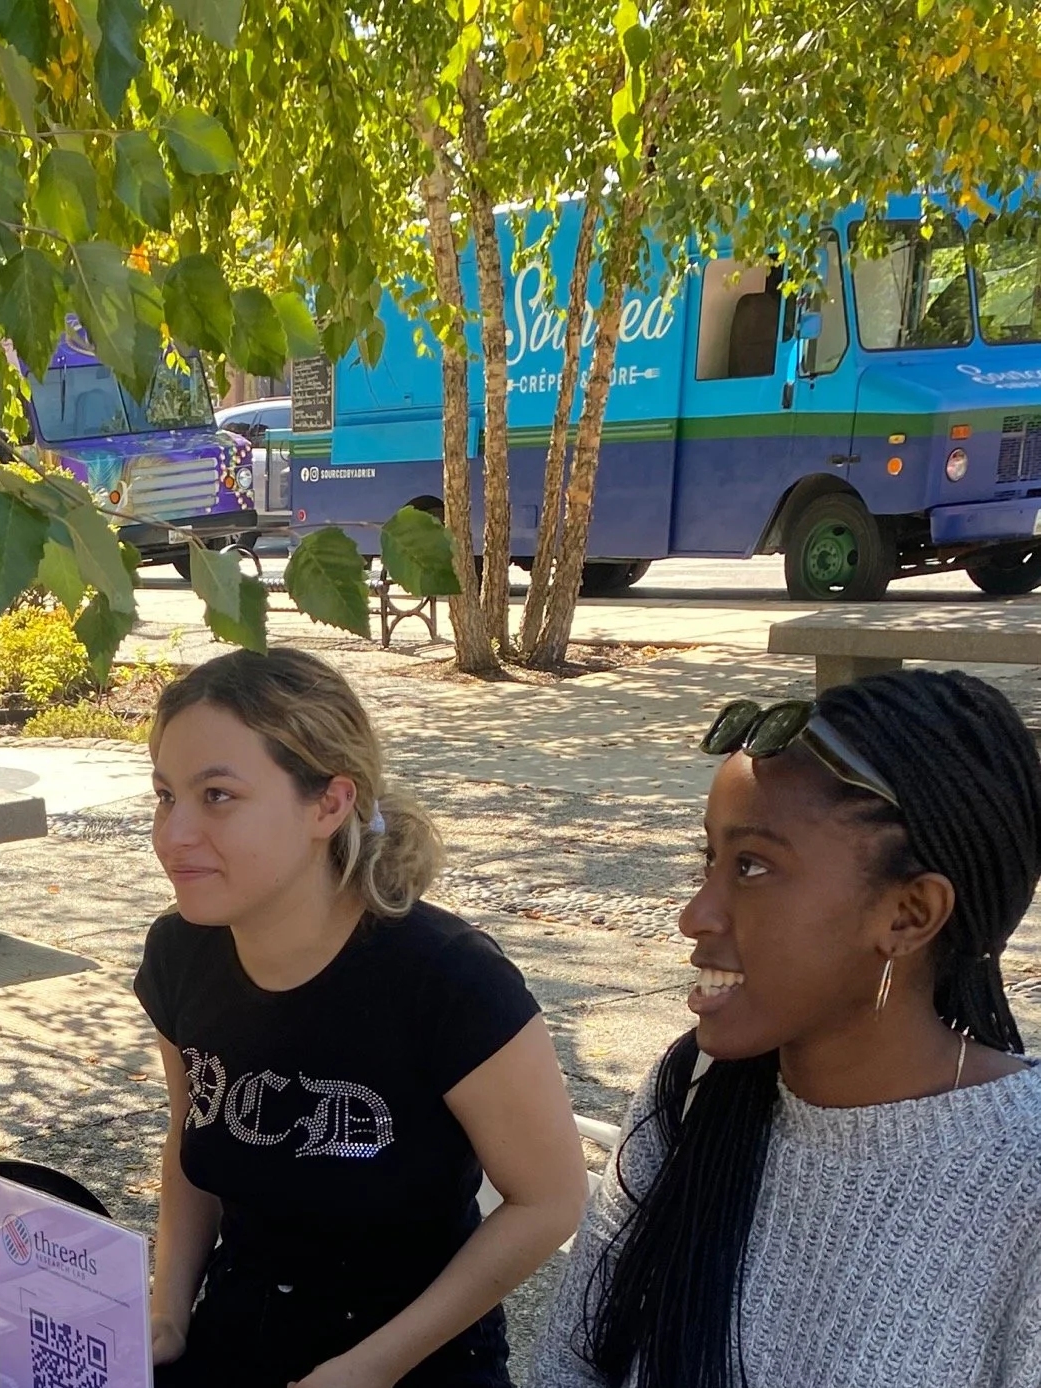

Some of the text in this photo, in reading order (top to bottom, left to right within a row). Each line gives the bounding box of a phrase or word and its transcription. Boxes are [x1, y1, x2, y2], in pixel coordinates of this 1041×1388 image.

[506, 260, 684, 366] Soured
[519, 368, 563, 393] CRÊPE
[34, 1231, 97, 1275] threads
[35, 1252, 70, 1273] RESEARCH
